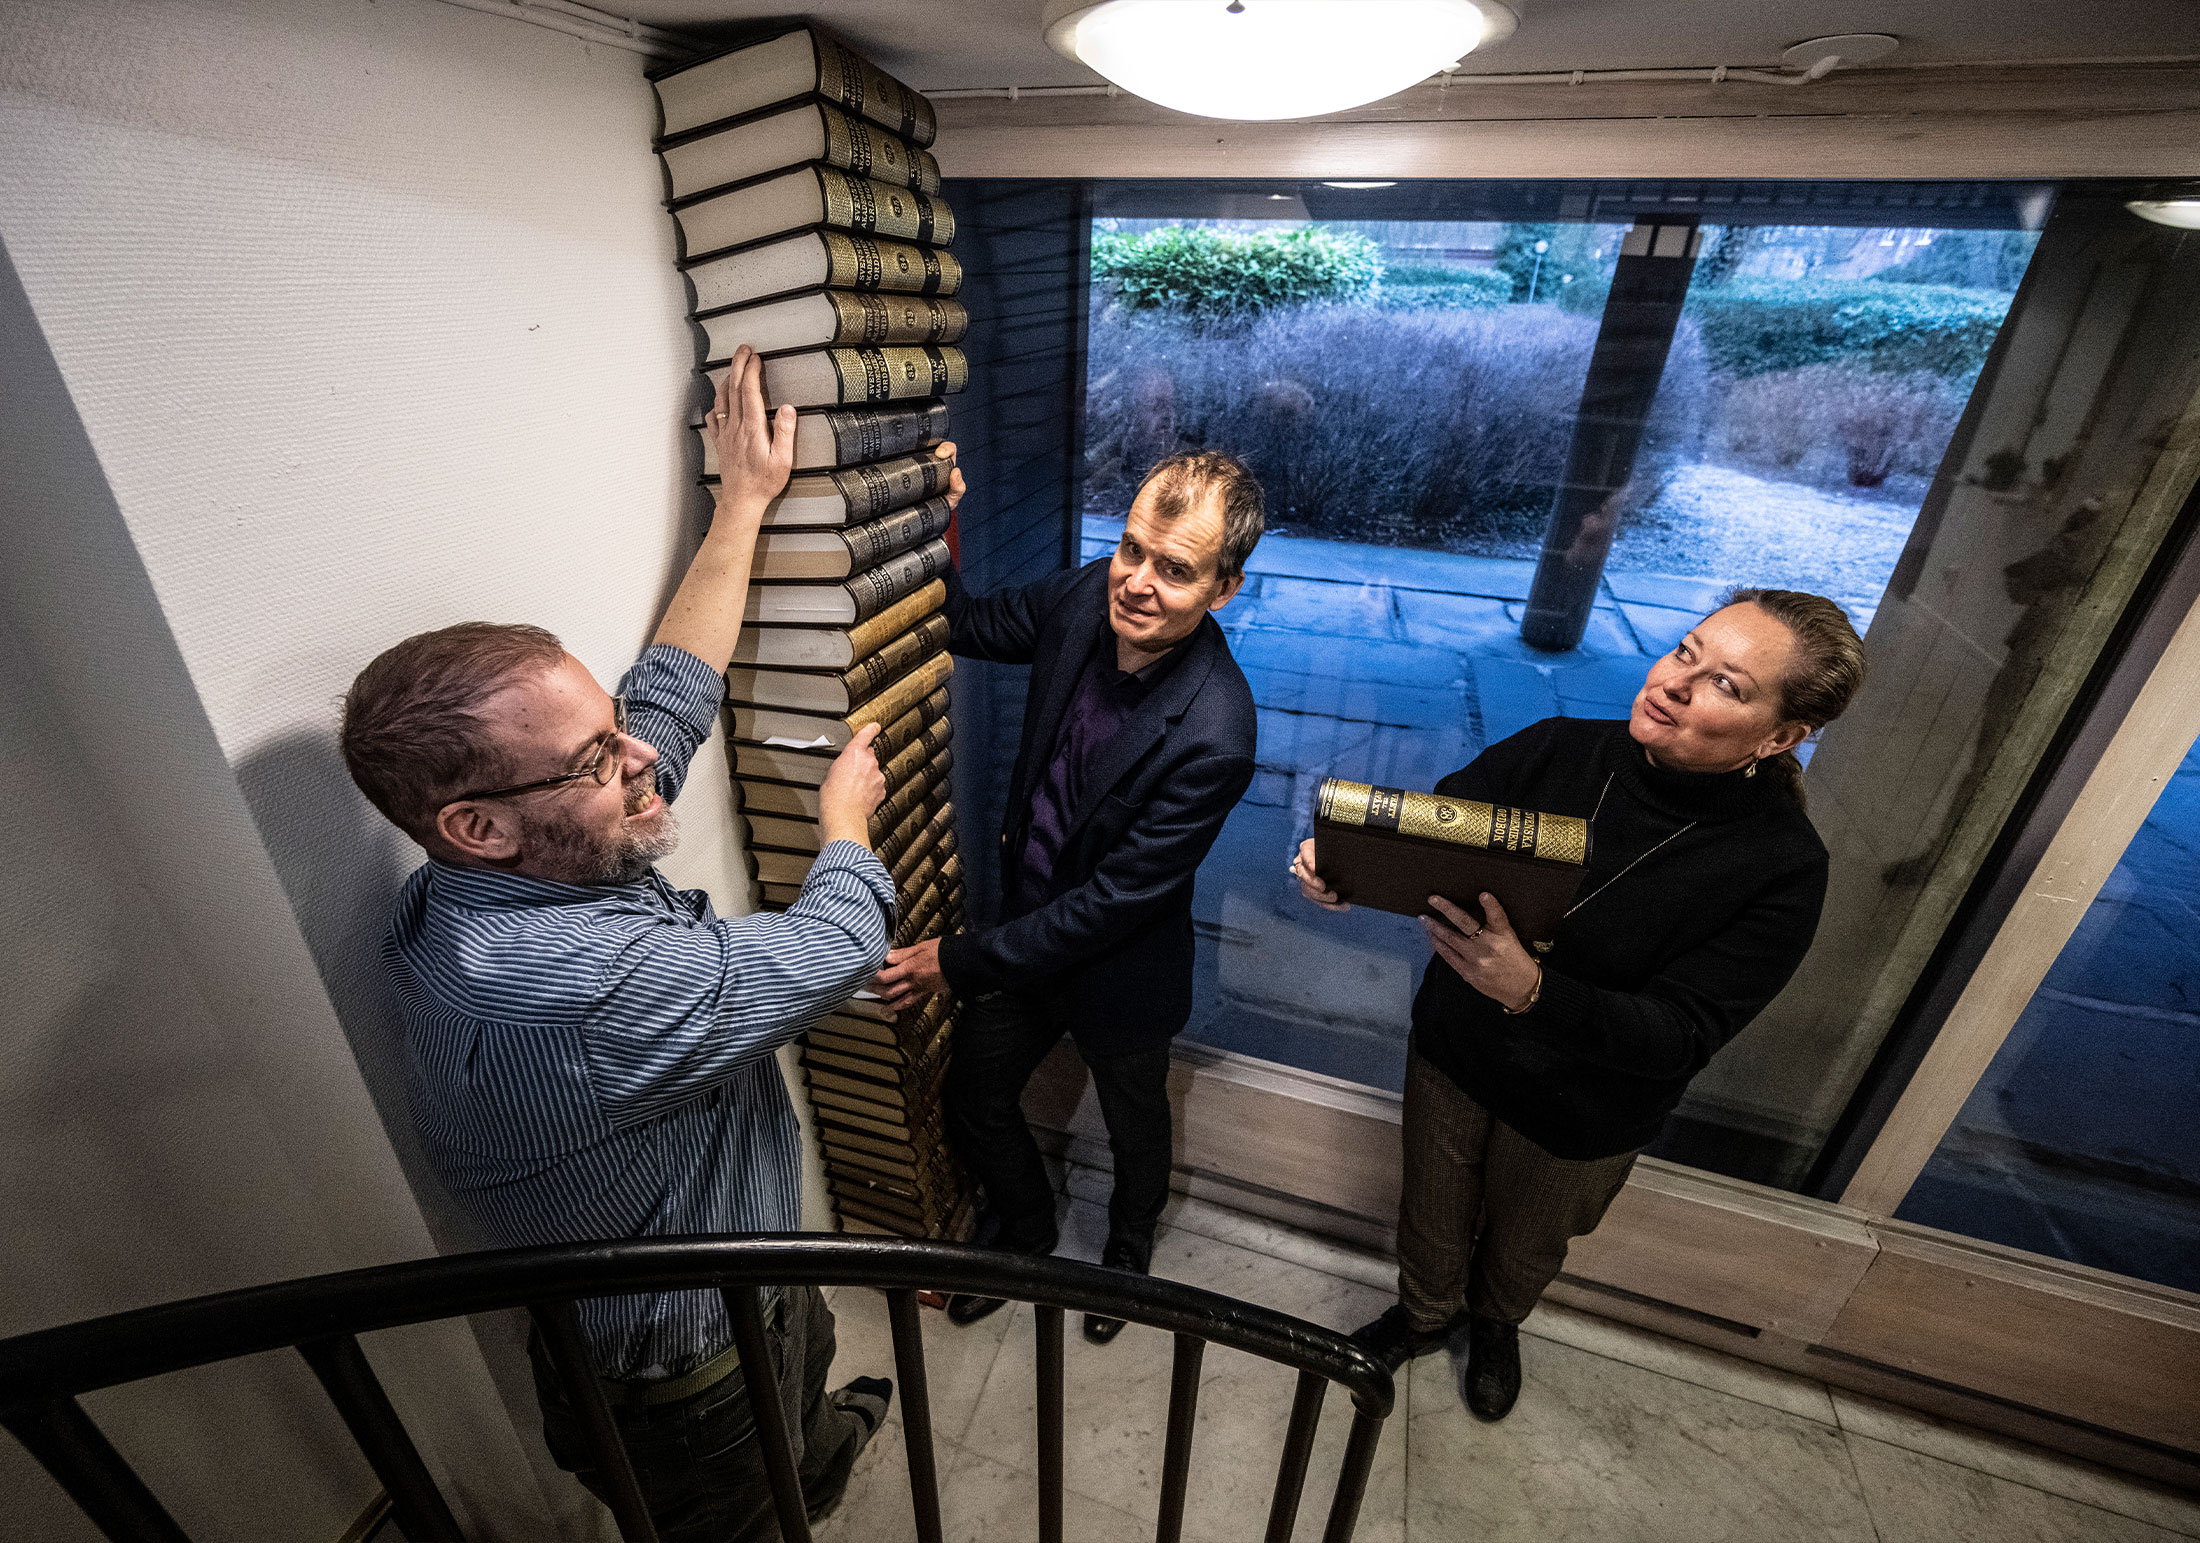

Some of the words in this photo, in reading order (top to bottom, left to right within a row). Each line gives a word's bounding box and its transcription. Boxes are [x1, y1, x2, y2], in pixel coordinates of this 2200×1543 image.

[852, 238, 866, 281] SVENSKA
[866, 240, 880, 280] ORDBOK
[873, 297, 888, 337] ORDBOK
[861, 352, 875, 395] SVENSKA
[865, 349, 882, 400] AKADEMIENS
[875, 353, 889, 393] ORDBOK
[906, 364, 915, 379] 32
[1439, 804, 1453, 820] 38
[1493, 808, 1508, 843] ORDBOK
[1506, 808, 1521, 851] AKADEMIENS
[1521, 811, 1535, 849] SVENSKA
